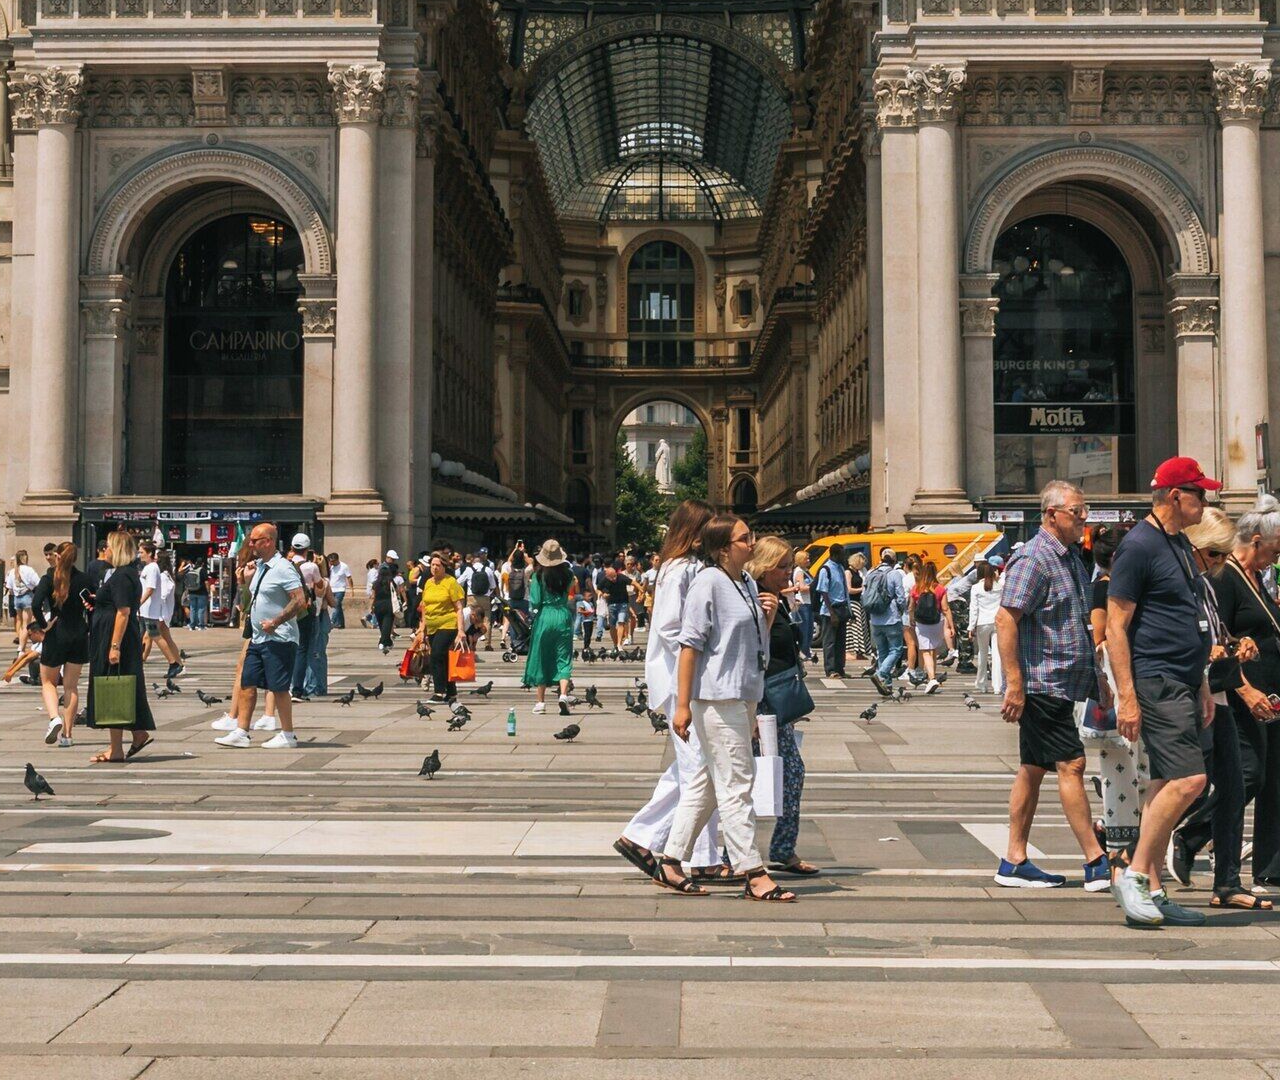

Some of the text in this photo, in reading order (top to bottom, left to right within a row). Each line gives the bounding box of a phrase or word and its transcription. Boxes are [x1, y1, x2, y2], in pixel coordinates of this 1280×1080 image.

[189, 330, 300, 350] CAMPARINO
[994, 360, 1076, 371] BURGER KING
[1029, 407, 1086, 427] Motta
